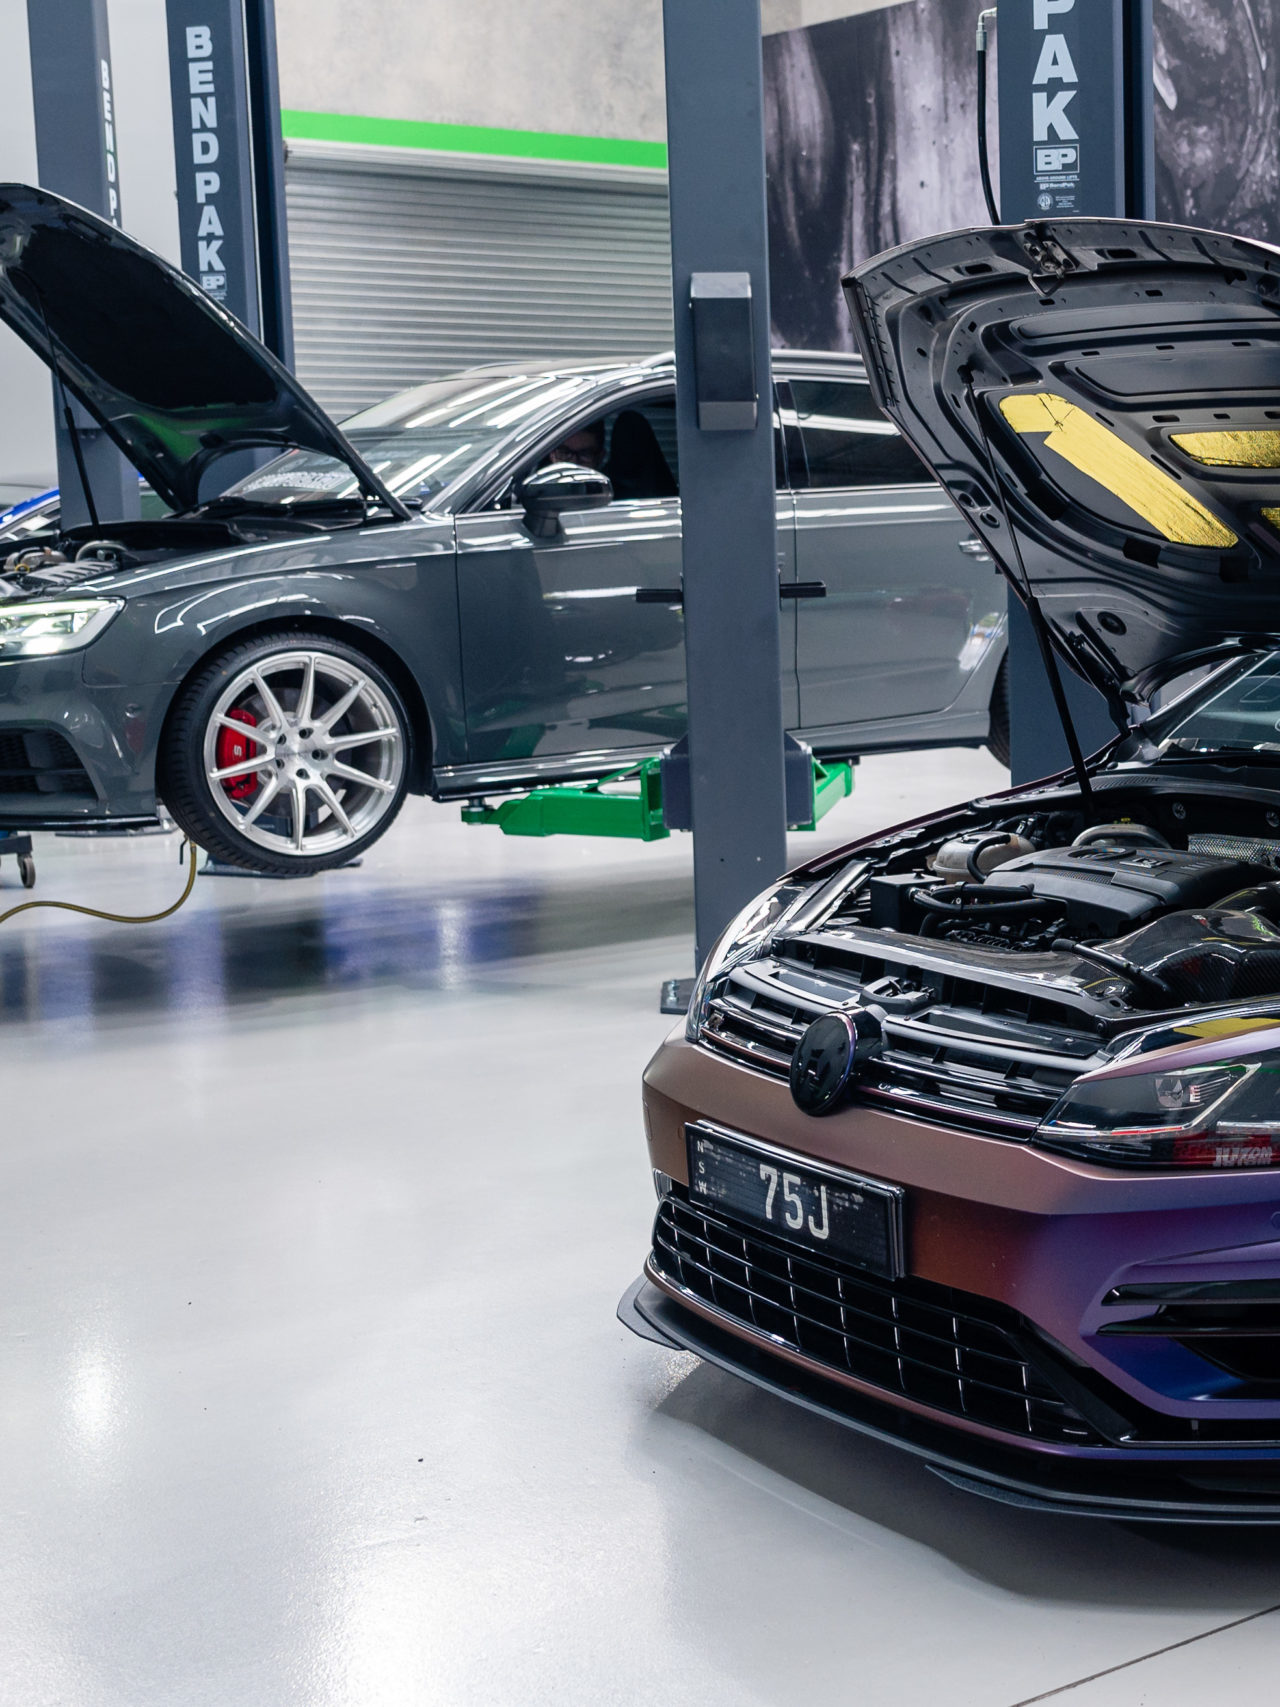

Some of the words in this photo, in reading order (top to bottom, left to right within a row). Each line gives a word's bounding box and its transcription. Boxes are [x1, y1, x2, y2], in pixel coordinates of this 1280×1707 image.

[101, 59, 117, 227] BENDP
[186, 25, 225, 271] BENDPAK
[1037, 148, 1076, 171] BP
[759, 1163, 829, 1240] 75J
